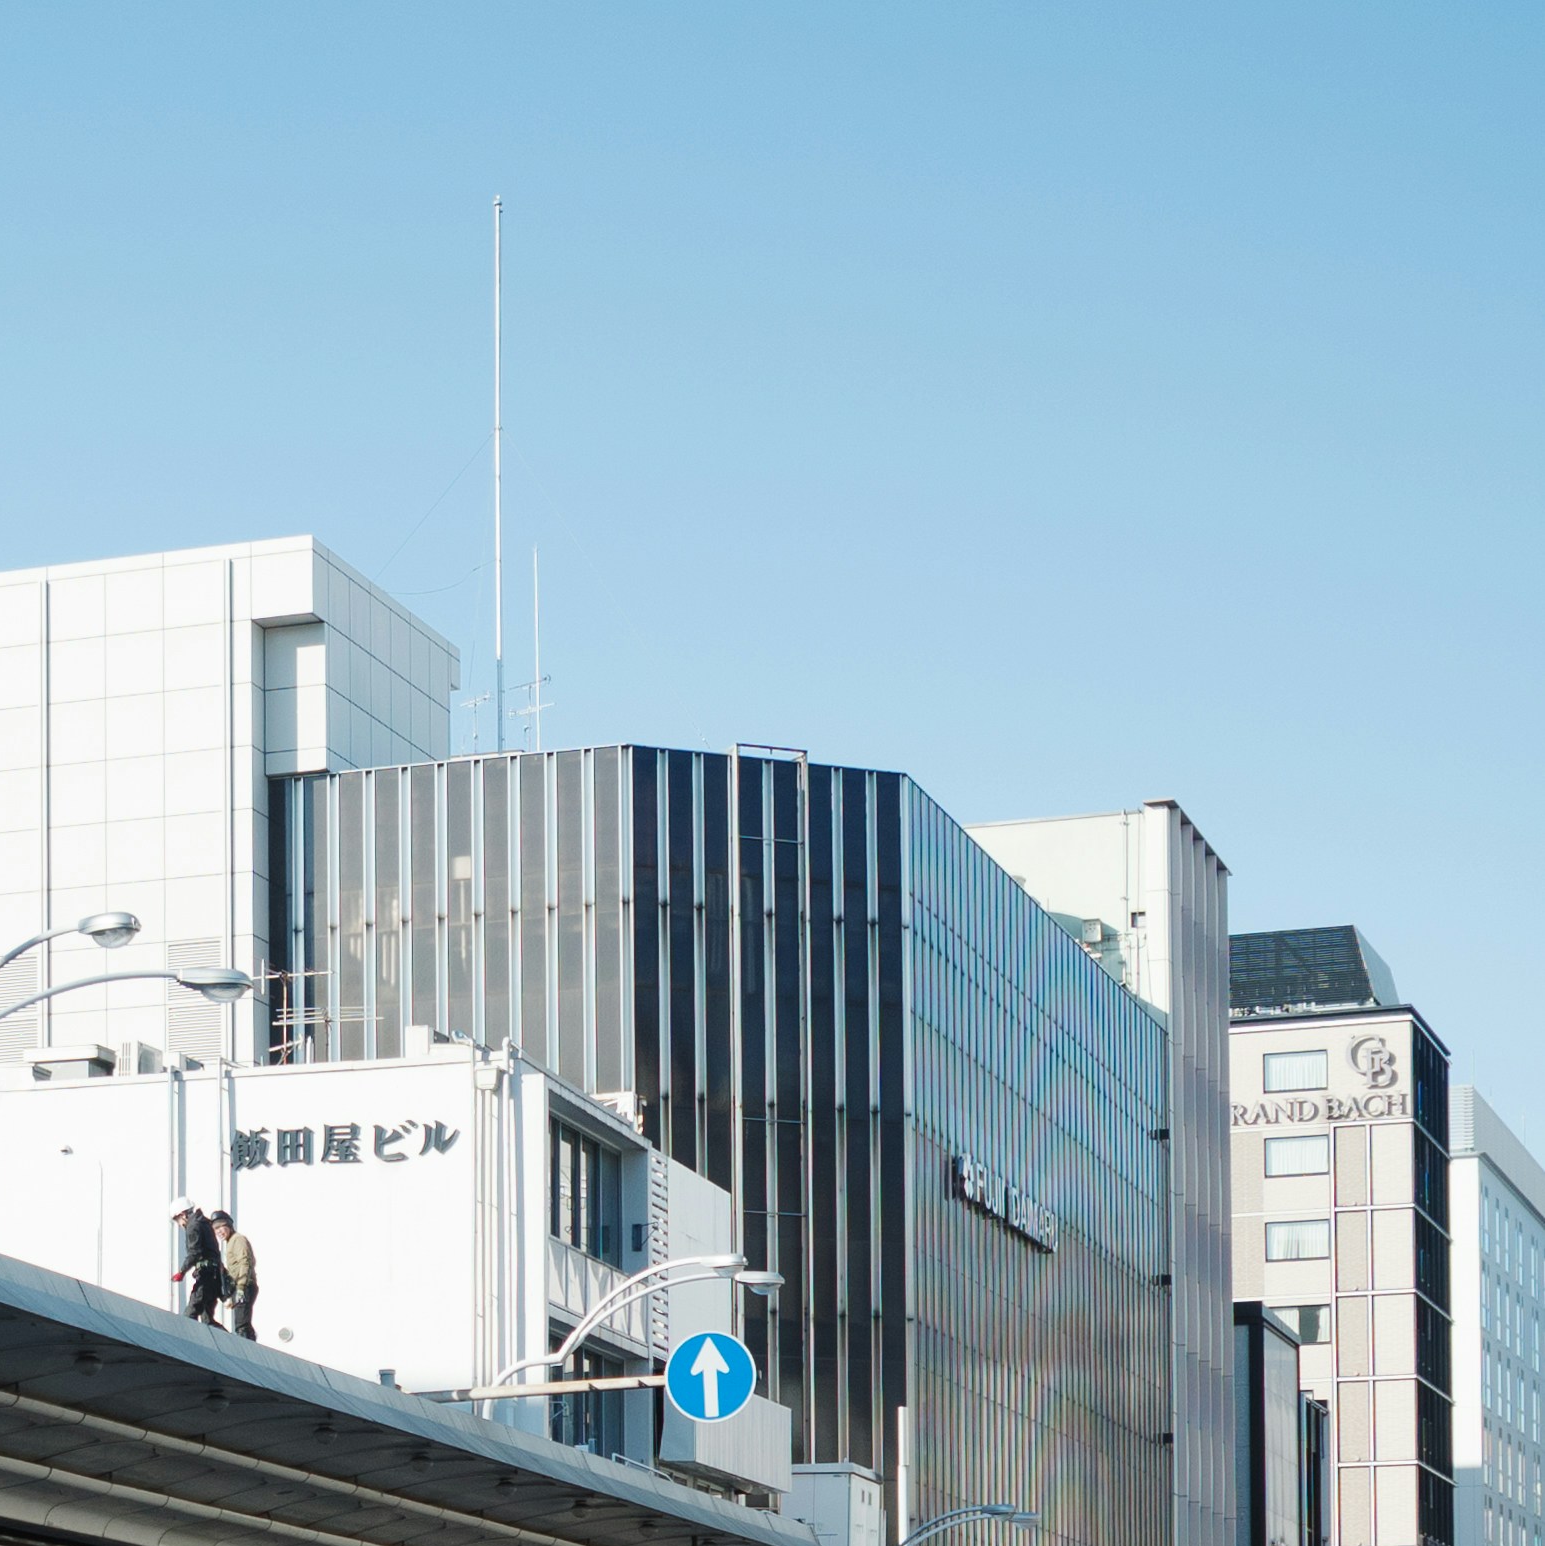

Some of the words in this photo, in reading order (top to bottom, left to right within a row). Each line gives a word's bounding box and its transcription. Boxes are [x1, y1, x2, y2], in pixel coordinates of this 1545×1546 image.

[1230, 1097, 1320, 1126] RAND
[1323, 1091, 1409, 1121] BACH
[231, 1120, 460, 1171] 飯田屋ビル
